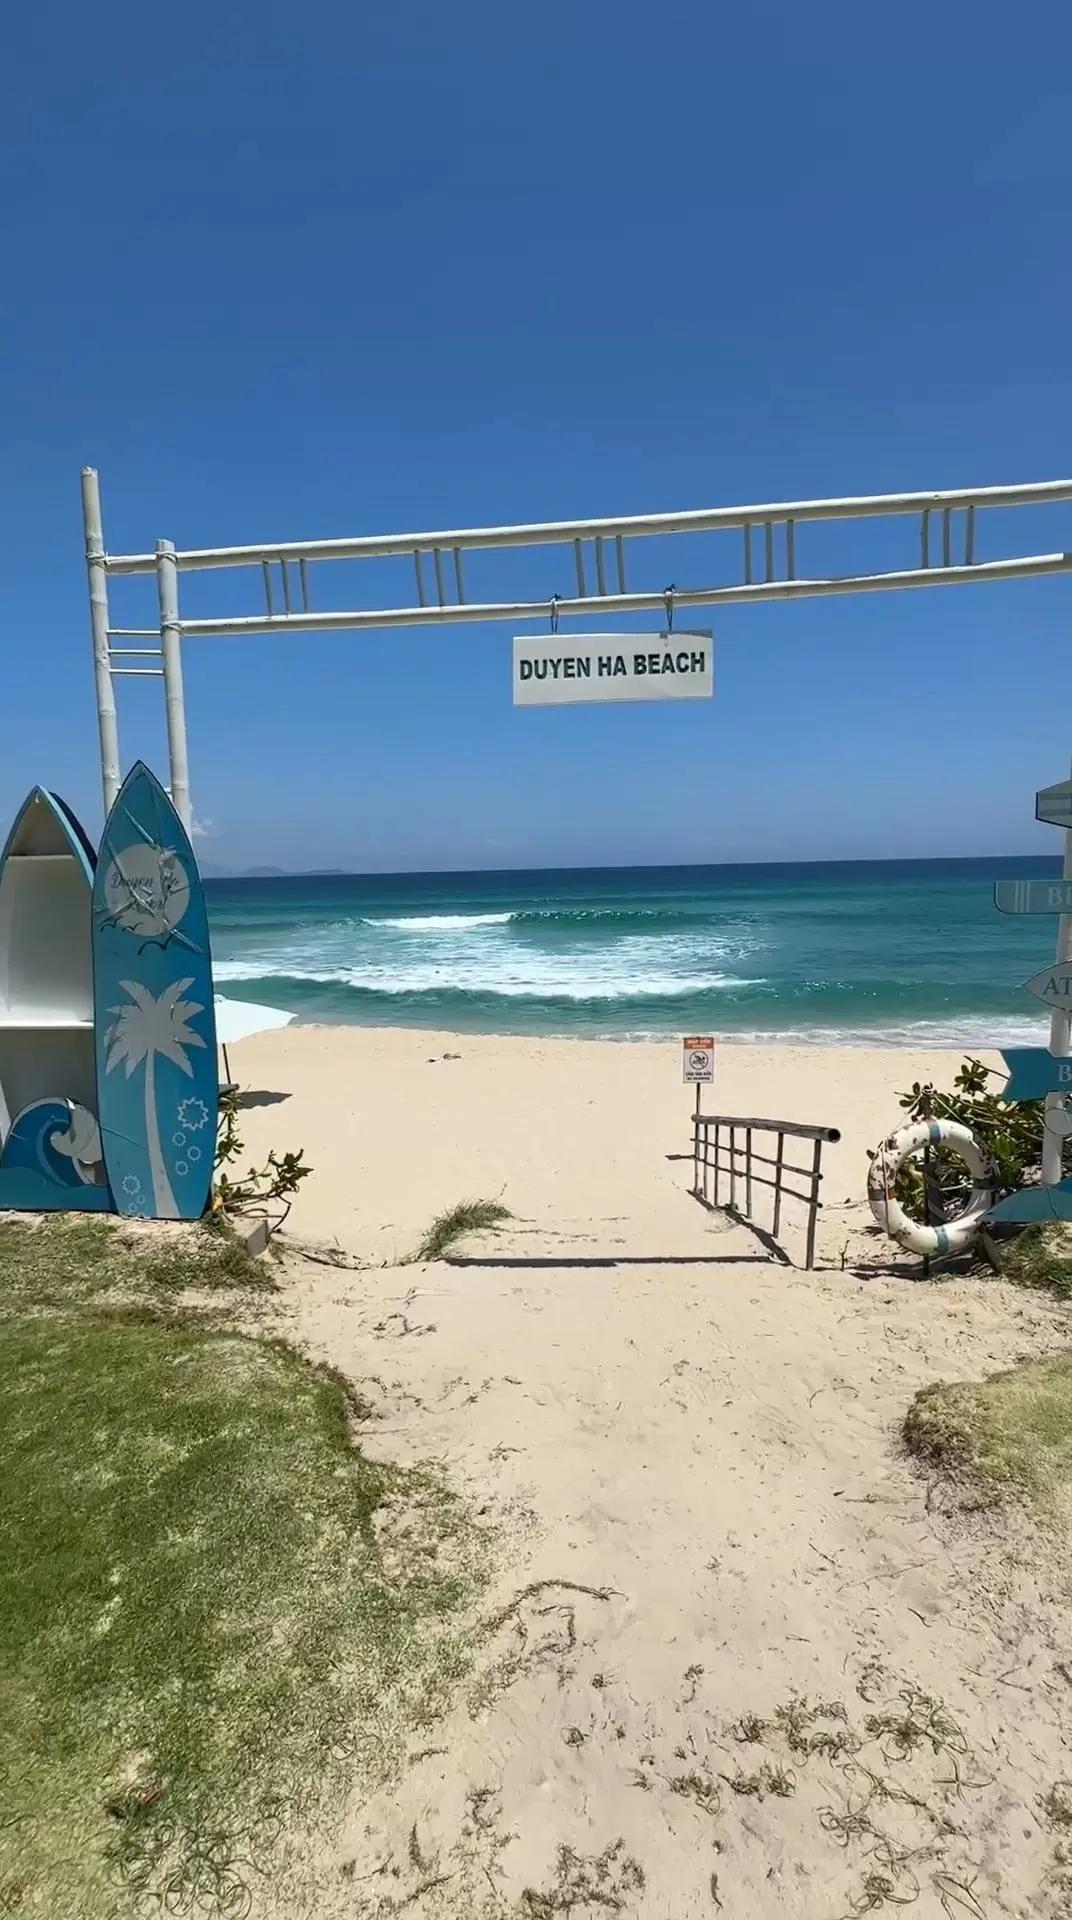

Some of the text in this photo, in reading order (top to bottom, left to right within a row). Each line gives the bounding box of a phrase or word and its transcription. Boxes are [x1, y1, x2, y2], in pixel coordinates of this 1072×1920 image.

[520, 651, 705, 680] DUYEN HA BEACH
